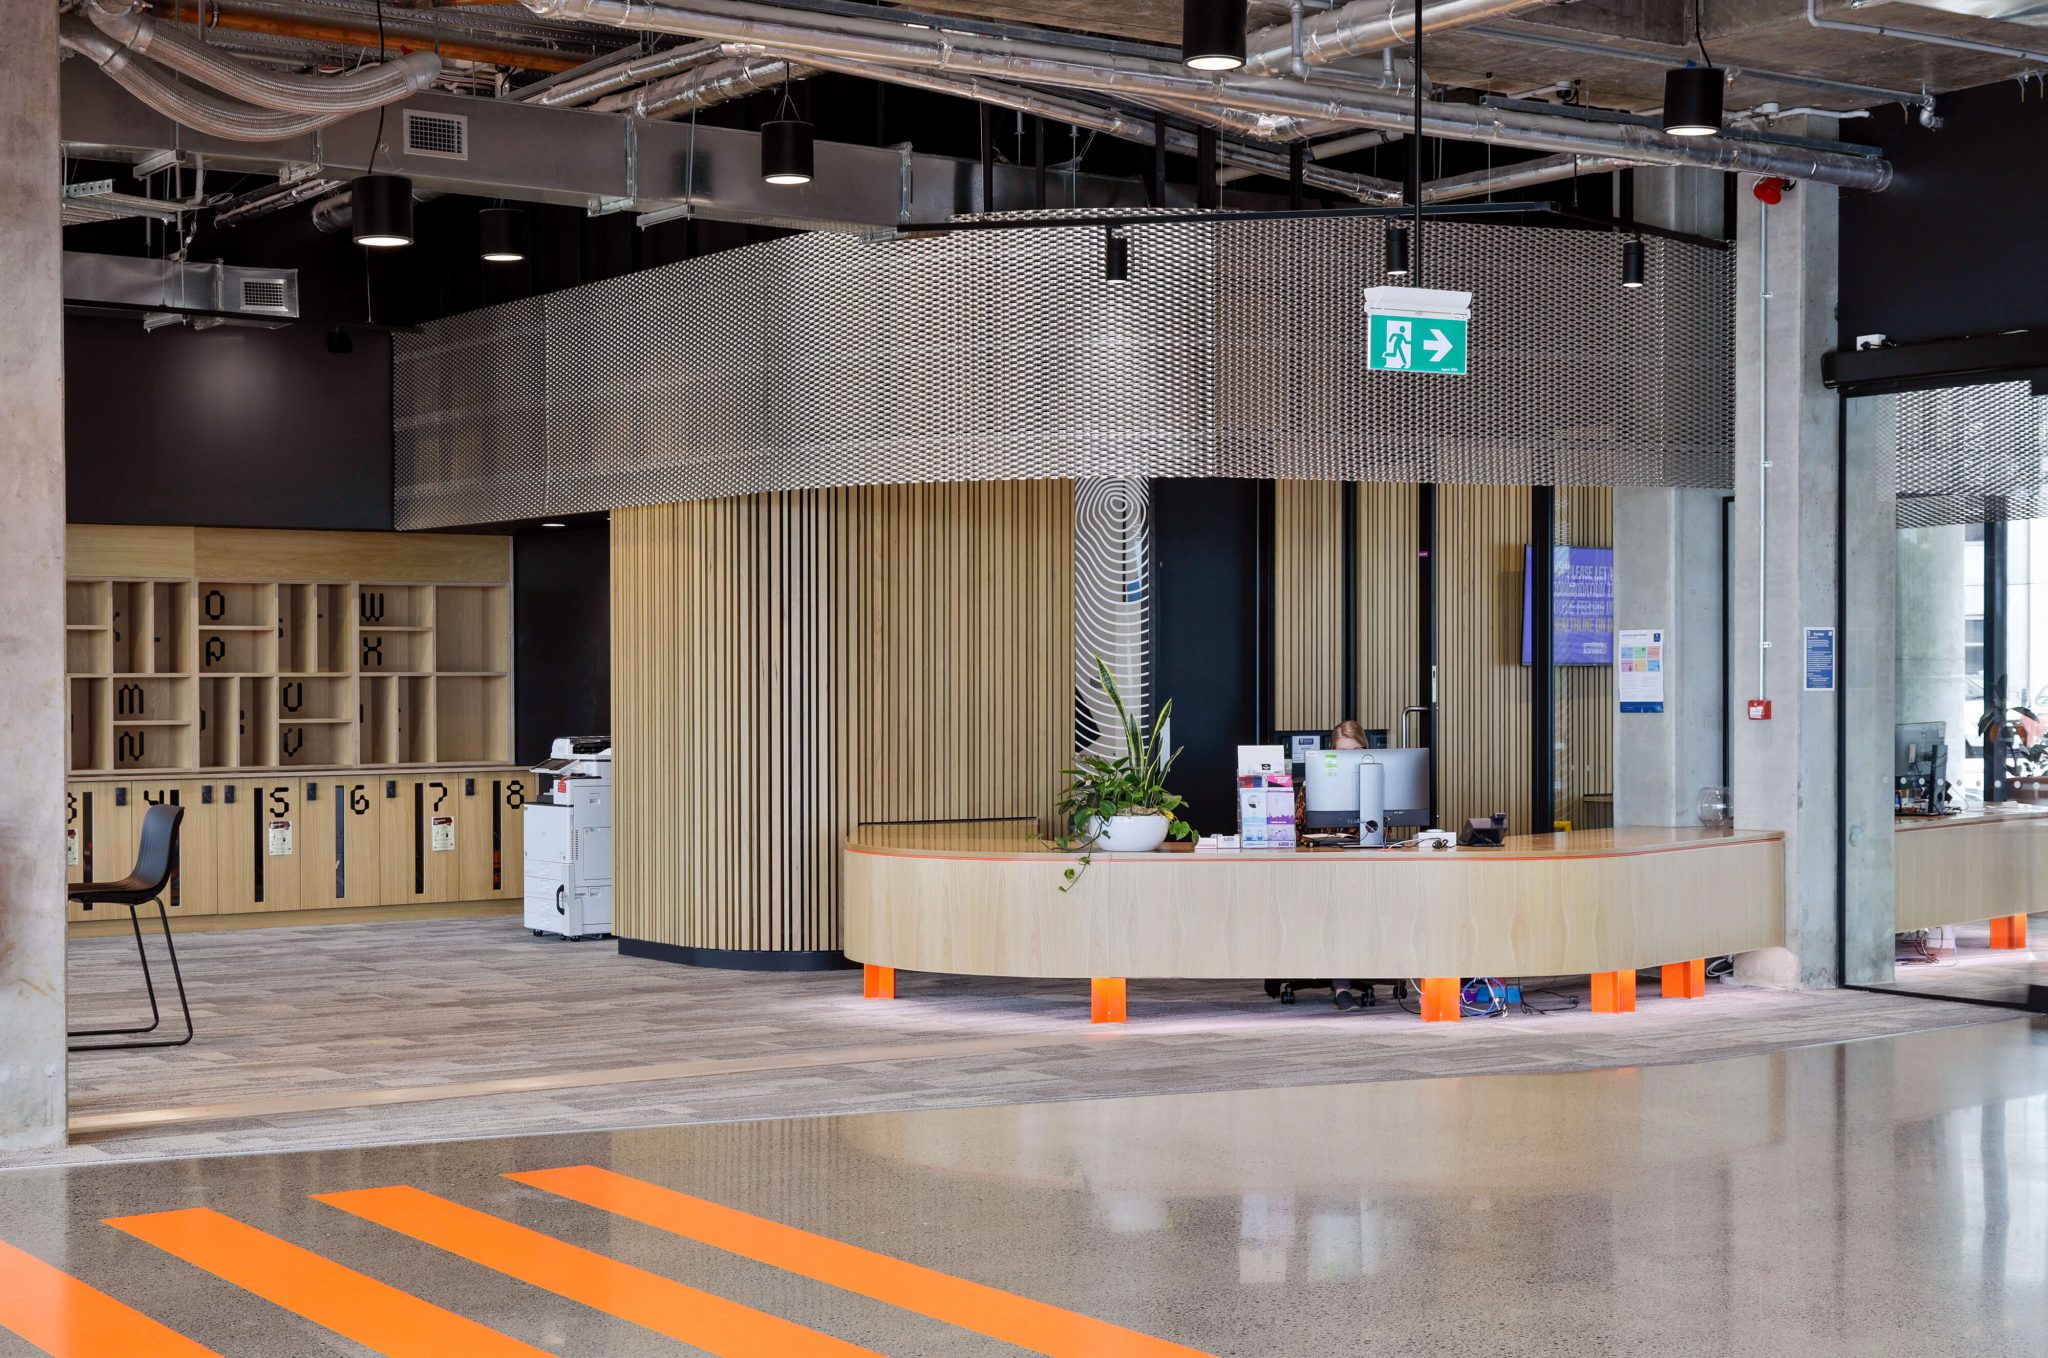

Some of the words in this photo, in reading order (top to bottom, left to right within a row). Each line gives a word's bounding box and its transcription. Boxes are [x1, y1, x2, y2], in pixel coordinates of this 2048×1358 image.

[205, 590, 225, 620] O
[206, 637, 225, 667] P
[363, 637, 382, 666] X
[269, 787, 290, 818] 5
[350, 785, 369, 814] 6
[429, 782, 448, 811] 7
[506, 780, 524, 809] 8
